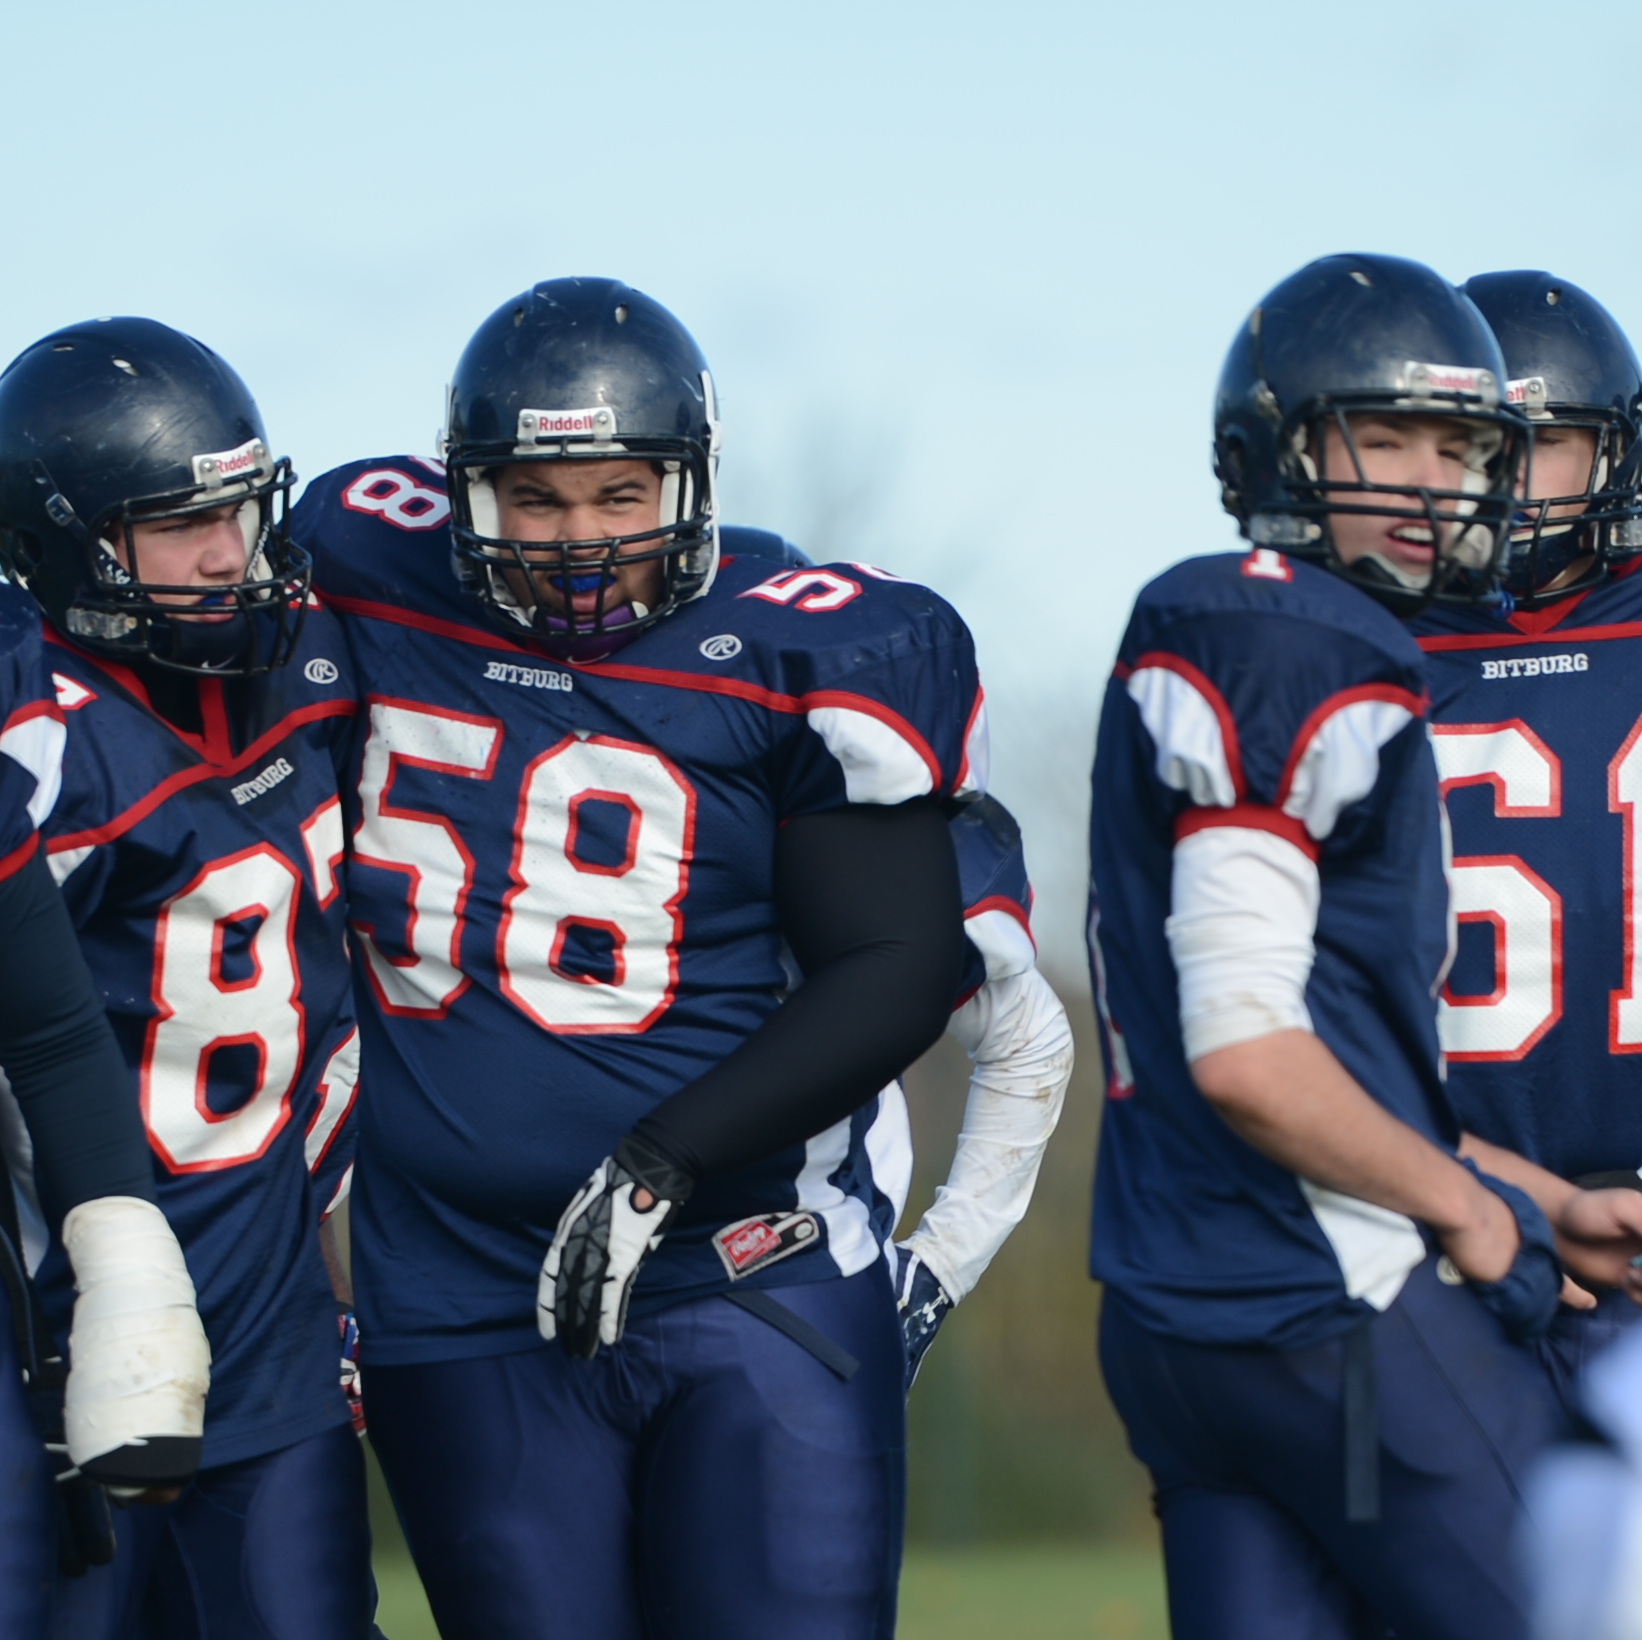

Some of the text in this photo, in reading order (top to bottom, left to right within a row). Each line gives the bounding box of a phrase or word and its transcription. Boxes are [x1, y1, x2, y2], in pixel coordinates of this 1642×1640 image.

[538, 414, 593, 431] Riddell
[483, 661, 574, 692] BITBURG
[1481, 652, 1589, 679] BITBURG
[230, 757, 294, 806] BITBURG
[347, 692, 697, 1036] 58
